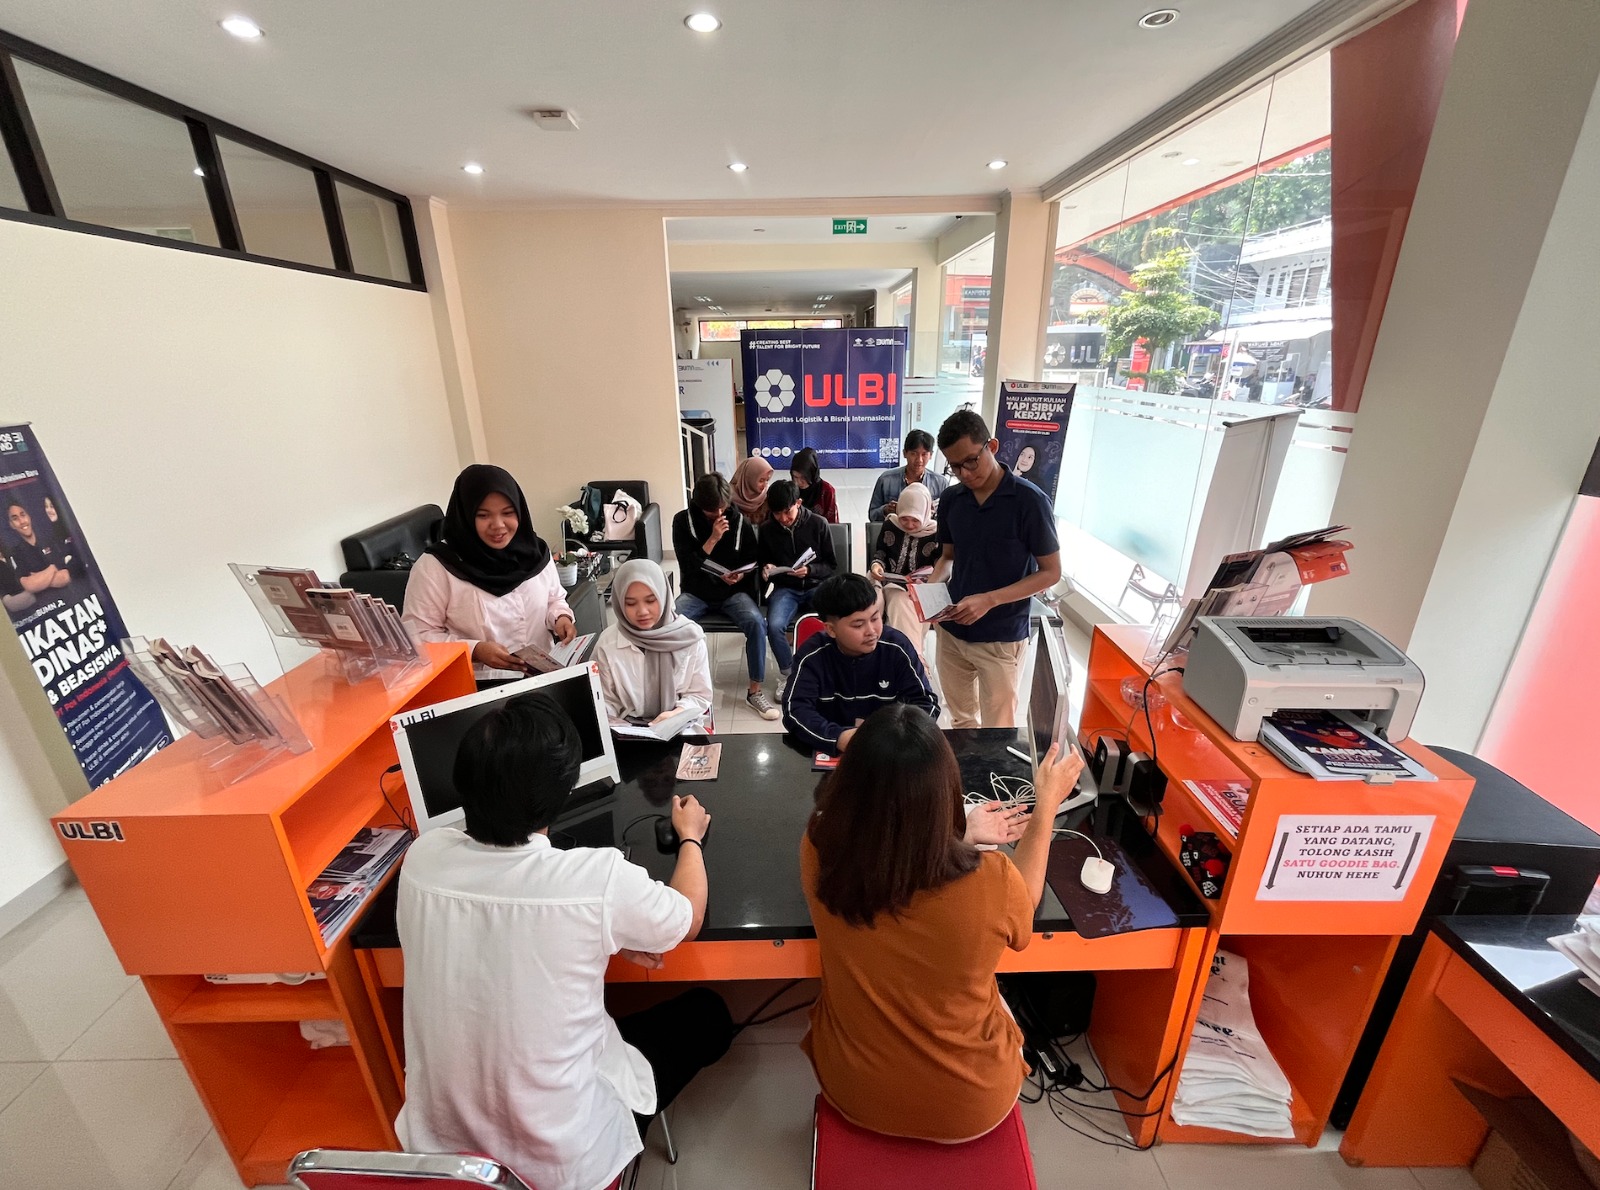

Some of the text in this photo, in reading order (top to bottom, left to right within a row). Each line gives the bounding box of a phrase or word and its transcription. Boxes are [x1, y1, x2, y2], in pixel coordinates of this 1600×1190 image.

[804, 373, 897, 407] ULBI
[1006, 402, 1065, 412] TAPI SIBUK
[795, 416, 822, 424] Logistik
[1014, 411, 1053, 421] KERJA?
[18, 594, 104, 660] IKATAN
[47, 645, 121, 705] & BEASISWA
[77, 677, 107, 701] Indonesia
[400, 709, 437, 728] ULBI
[58, 821, 125, 841] ULBI
[1295, 825, 1412, 834] SETIAP ADA TAMU
[1303, 837, 1395, 847] YANG DATANG,
[1299, 849, 1395, 857] TOLONG KASIH
[1283, 860, 1400, 868] SATU GOODIE BAG.
[1297, 871, 1380, 879] NUHUN HEHE
